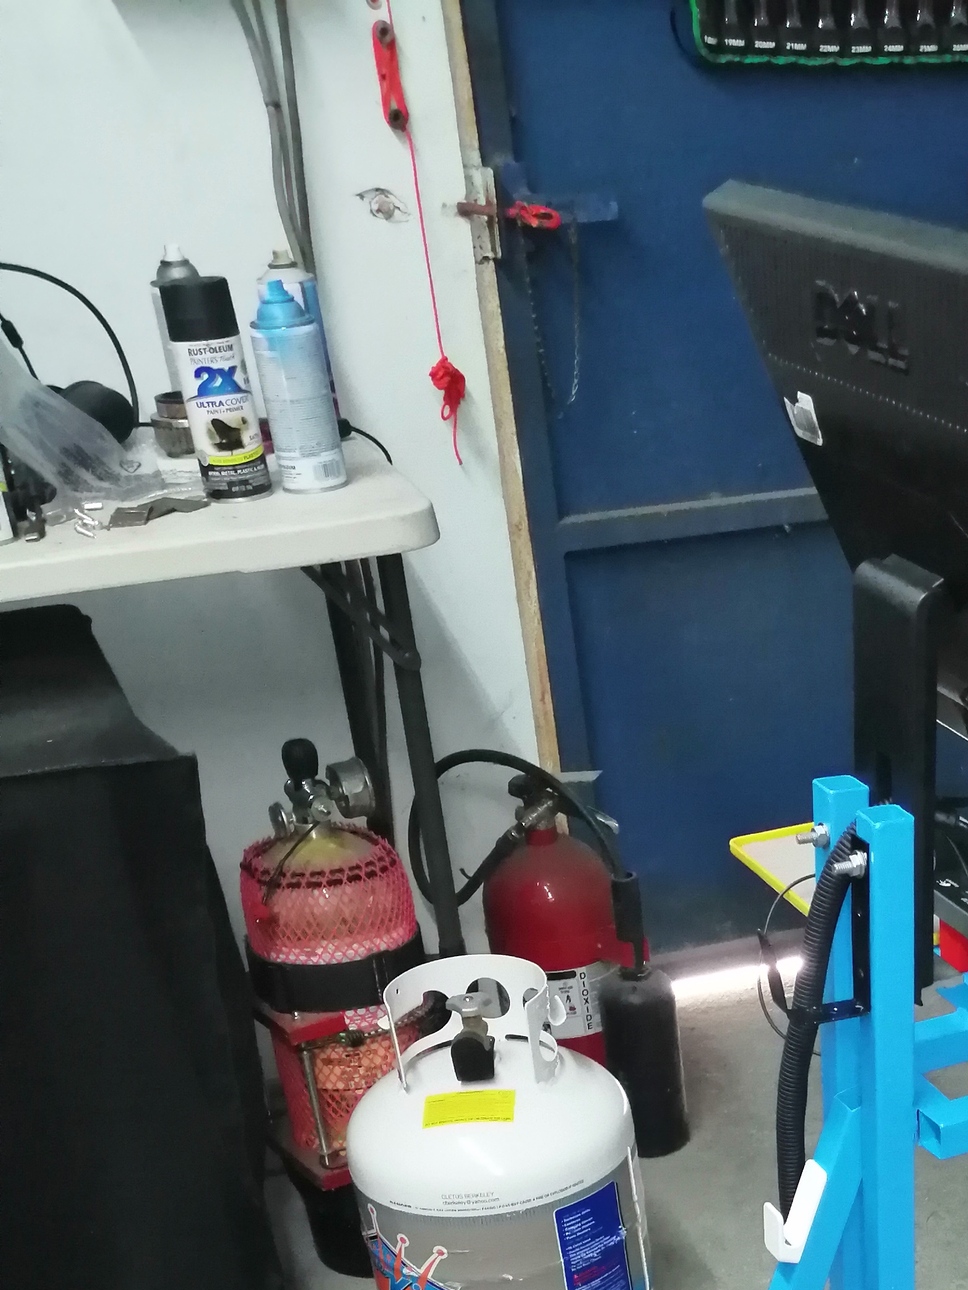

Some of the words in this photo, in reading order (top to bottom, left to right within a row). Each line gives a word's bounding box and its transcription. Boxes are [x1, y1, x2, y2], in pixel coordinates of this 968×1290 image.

[194, 365, 242, 397] 2X
[196, 400, 225, 409] ULTRA
[580, 971, 593, 1030] DIOXIDE
